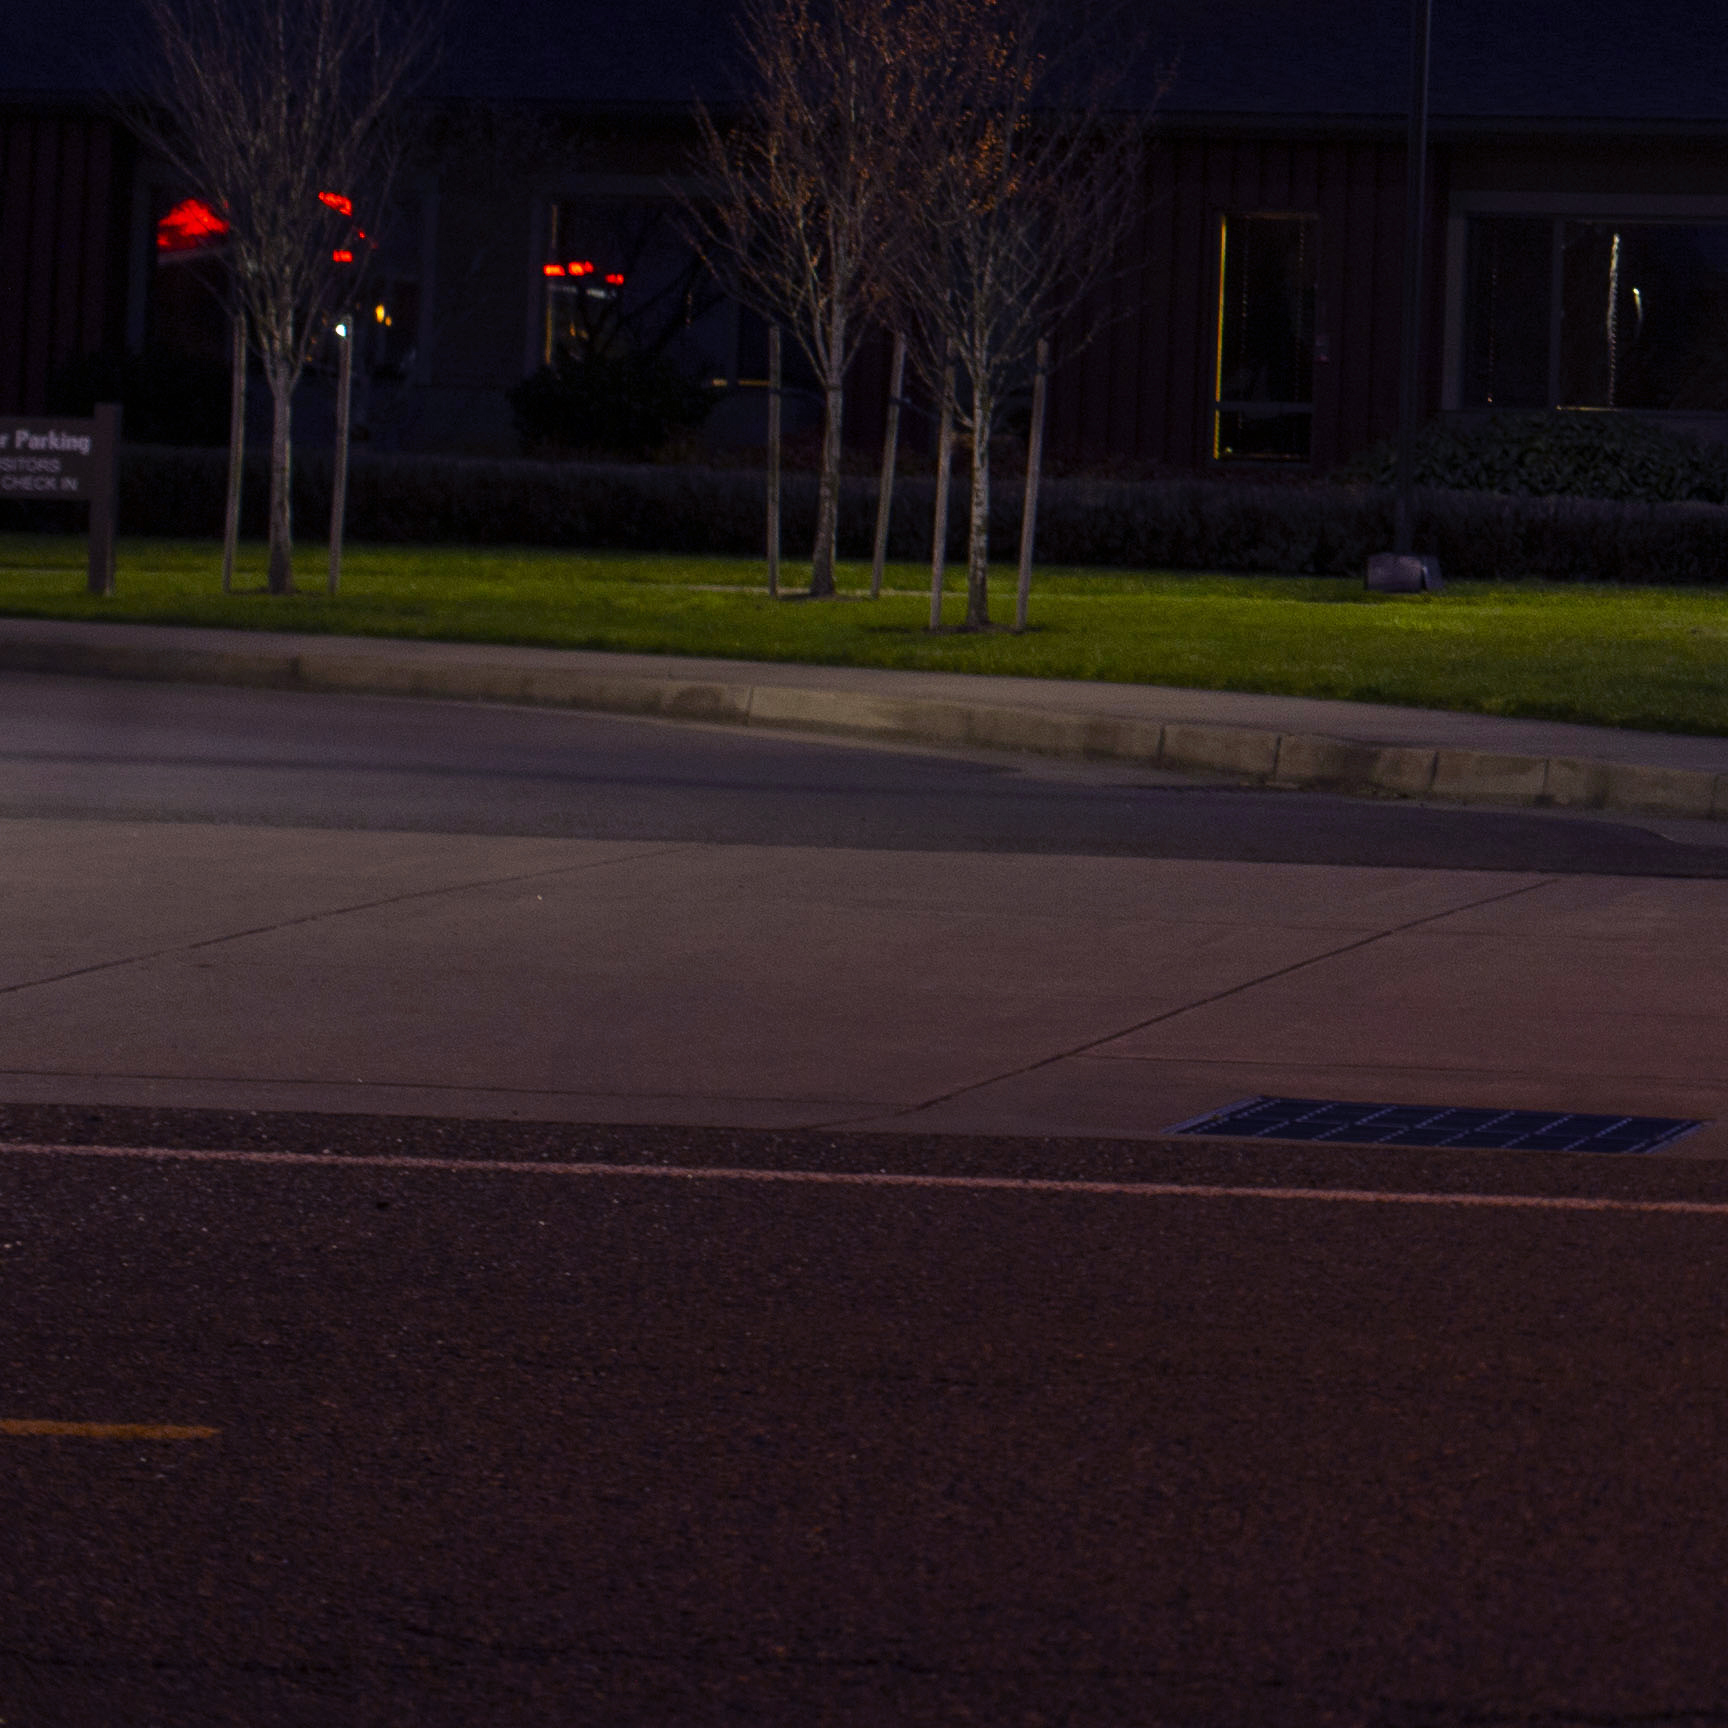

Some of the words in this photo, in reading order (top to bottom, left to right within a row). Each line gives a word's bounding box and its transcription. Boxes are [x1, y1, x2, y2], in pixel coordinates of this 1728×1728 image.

[15, 429, 90, 455] Parking
[2, 475, 56, 491] CHECK
[60, 477, 77, 491] IN
